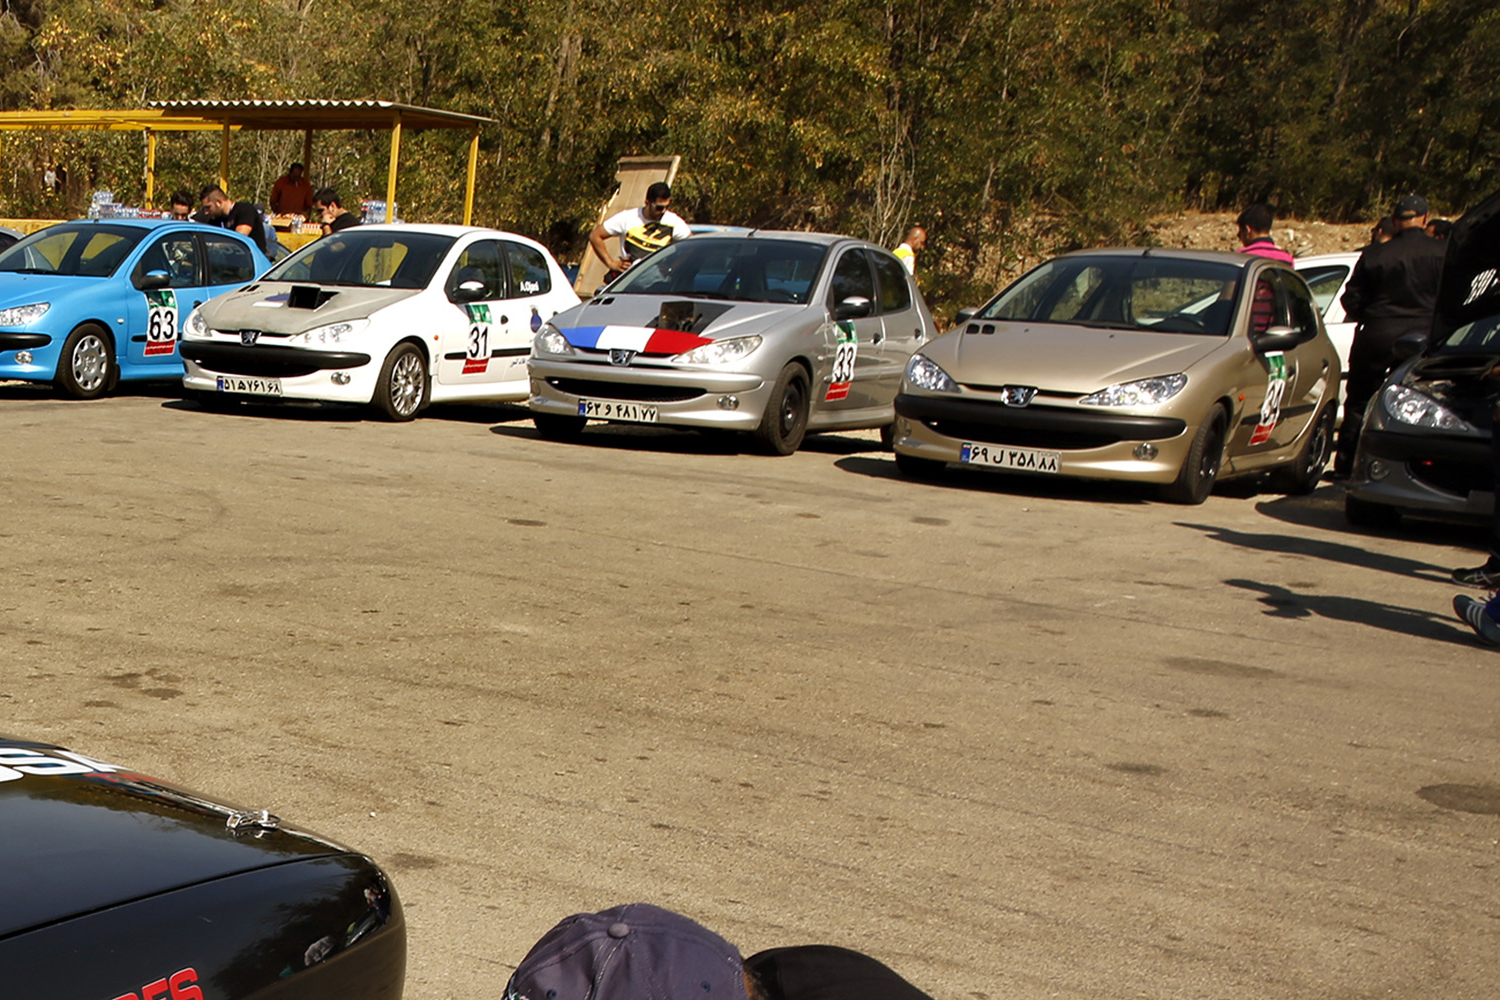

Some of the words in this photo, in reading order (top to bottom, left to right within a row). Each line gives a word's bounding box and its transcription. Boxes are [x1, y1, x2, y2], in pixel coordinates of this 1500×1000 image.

[150, 310, 174, 340] 63
[468, 326, 488, 358] 31
[835, 346, 853, 382] 33
